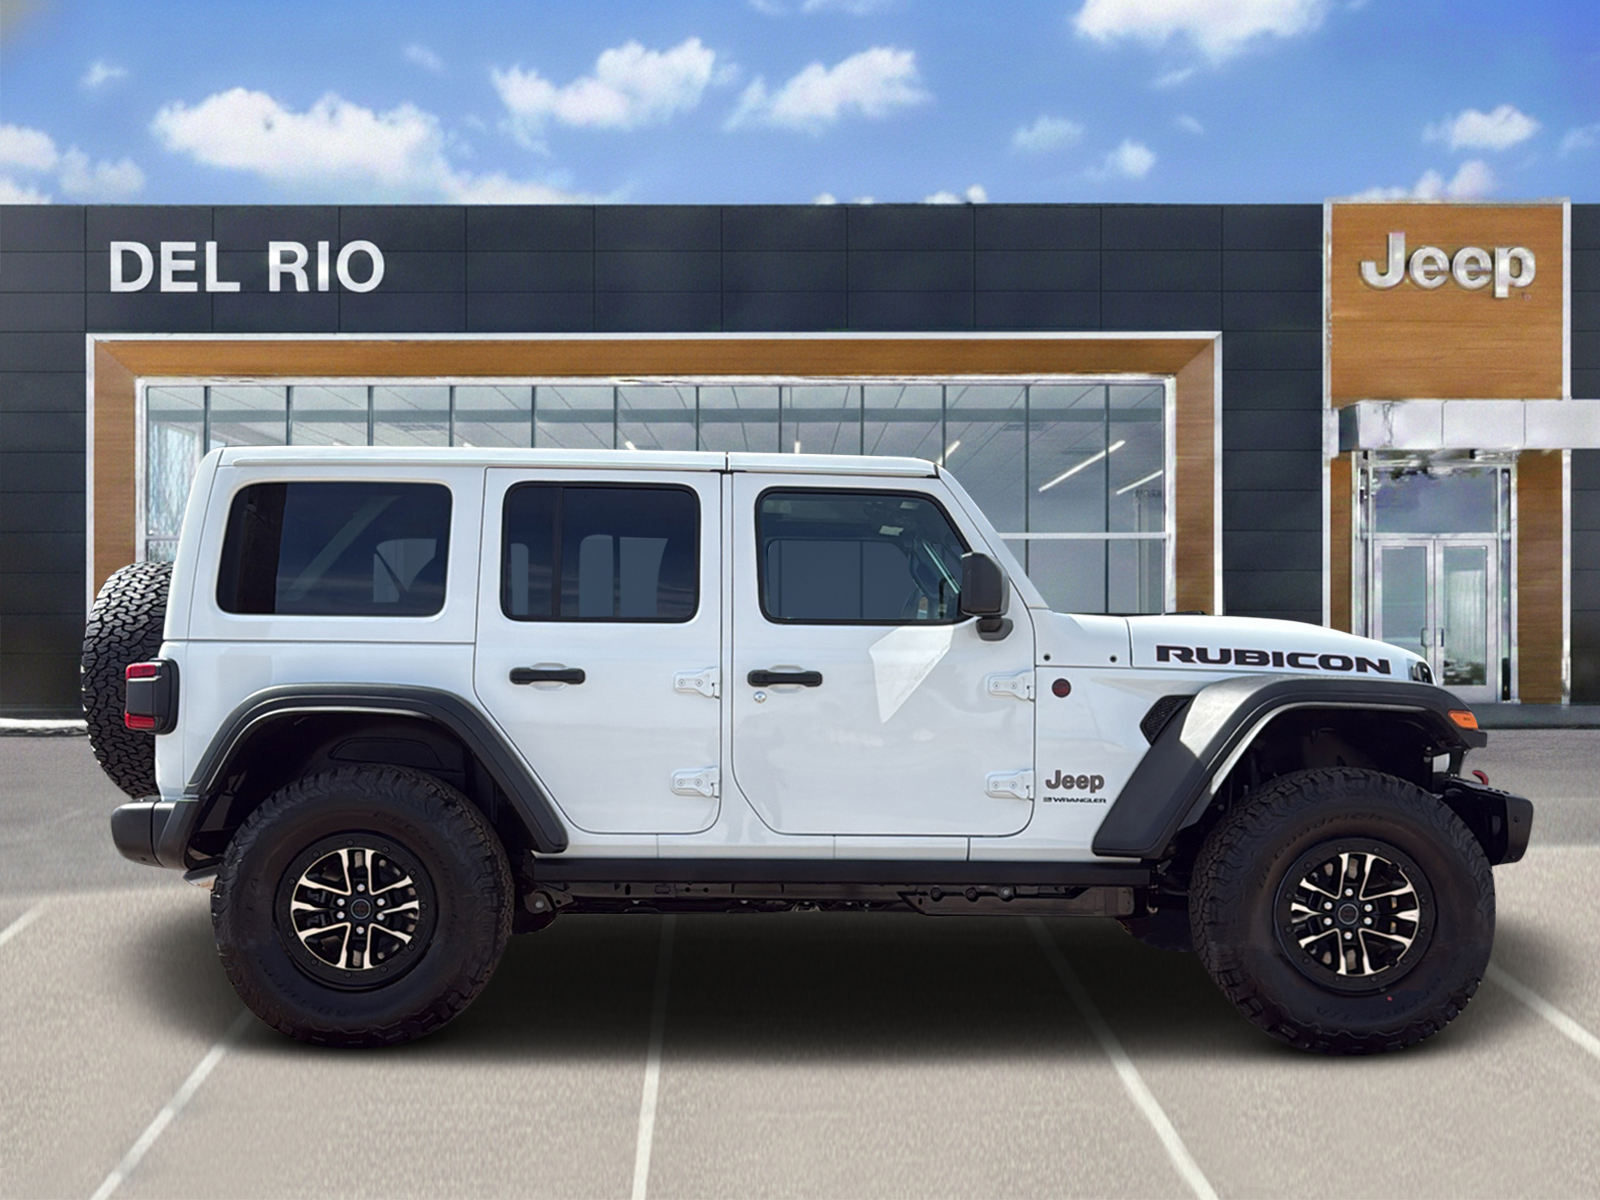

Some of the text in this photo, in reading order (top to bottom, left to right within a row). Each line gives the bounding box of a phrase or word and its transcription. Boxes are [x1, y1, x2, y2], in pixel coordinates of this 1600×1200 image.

[110, 240, 385, 293] DEL RIO
[1361, 231, 1536, 298] Jeep
[1156, 645, 1391, 675] RUBICON
[1045, 769, 1105, 794] Jeep
[1052, 796, 1107, 804] WRANGLER
